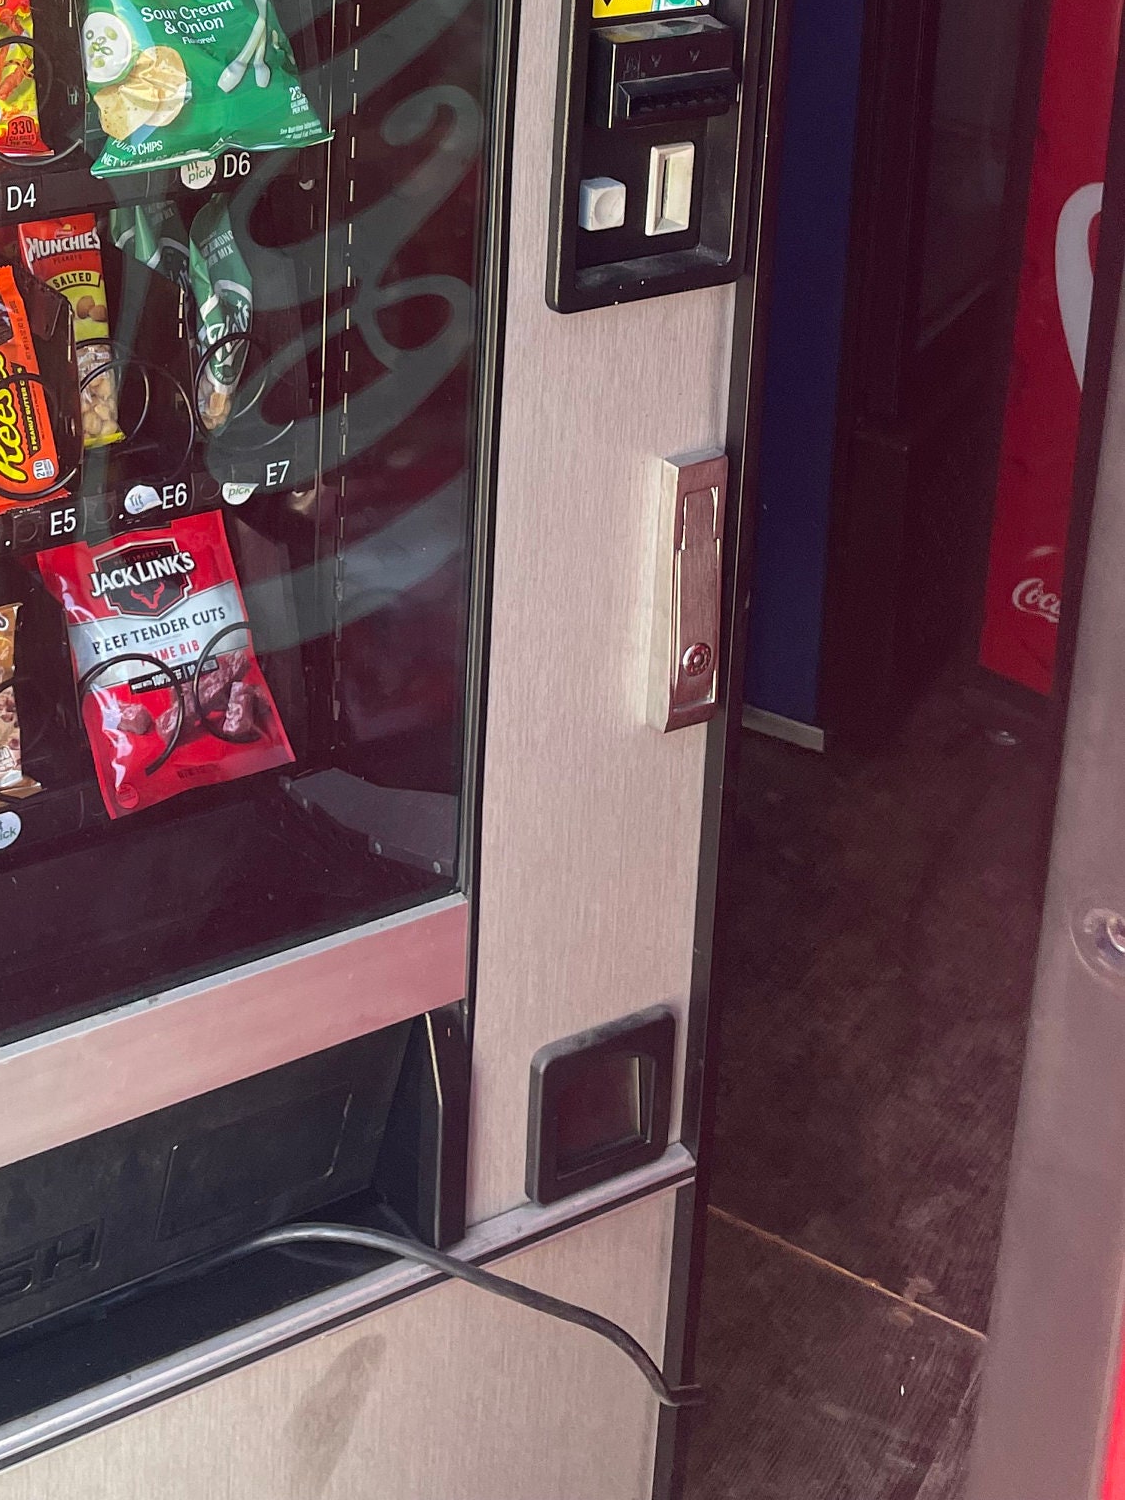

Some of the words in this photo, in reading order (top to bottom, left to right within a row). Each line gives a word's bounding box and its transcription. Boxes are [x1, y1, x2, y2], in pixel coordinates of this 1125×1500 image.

[141, 6, 177, 22] Sour
[179, 0, 234, 20] Cream
[164, 20, 177, 34] &
[178, 16, 224, 34] Onion
[11, 120, 31, 134] 330
[137, 140, 163, 154] CHIPS
[188, 168, 212, 183] pick
[224, 152, 251, 178] D6
[6, 185, 36, 211] D4
[26, 228, 101, 262] MUNCHIES
[53, 272, 92, 289] SALTED
[36, 461, 46, 478] 210
[265, 461, 290, 485] E7
[161, 484, 188, 508] E6
[50, 510, 76, 535] E5
[91, 568, 139, 597] JACK
[137, 552, 195, 581] LINK'S
[93, 635, 129, 654] BEEF
[131, 618, 189, 642] TENDER
[192, 606, 225, 626] CUTS
[181, 640, 200, 656] RIB
